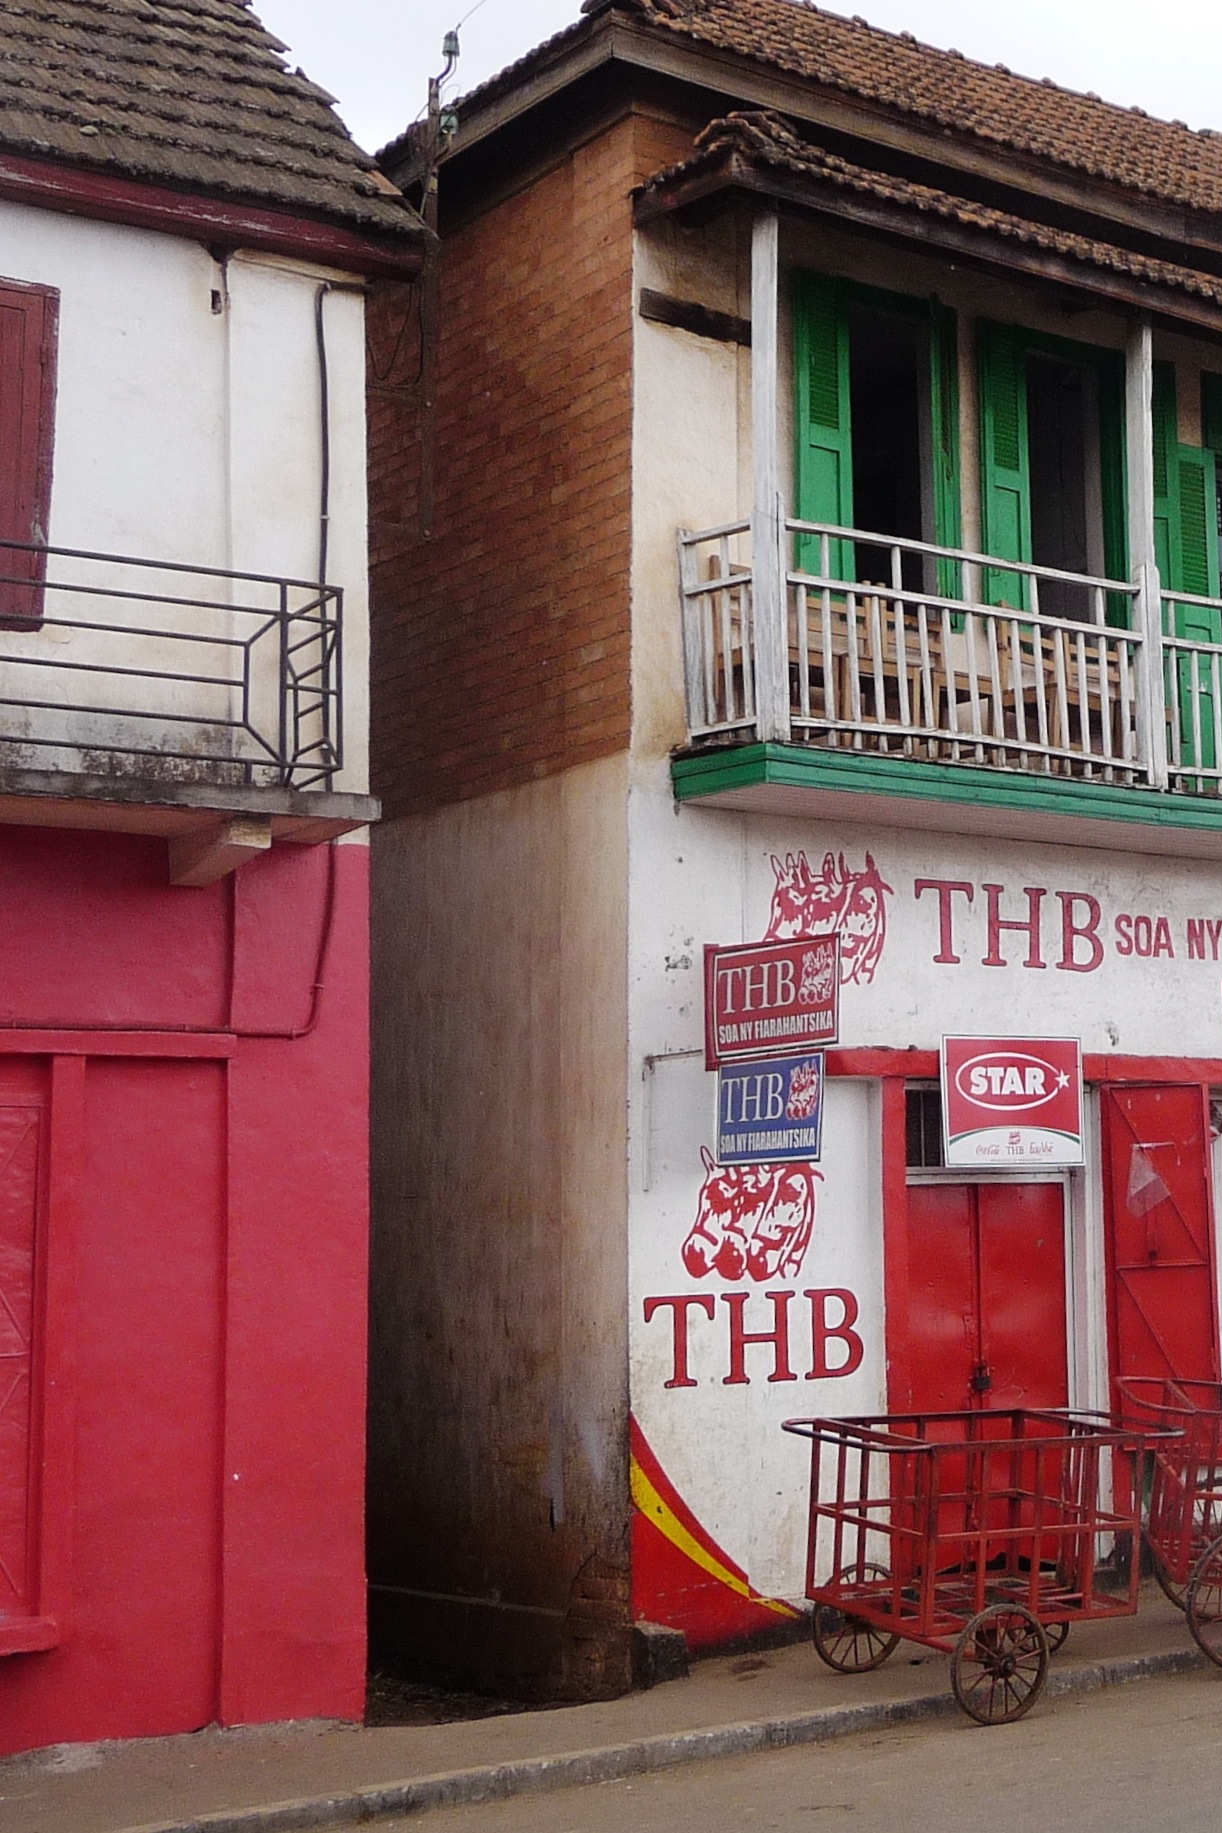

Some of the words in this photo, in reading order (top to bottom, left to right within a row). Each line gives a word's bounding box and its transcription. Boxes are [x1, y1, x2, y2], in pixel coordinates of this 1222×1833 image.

[914, 878, 1105, 973] THB
[1114, 914, 1175, 958] SOA
[1187, 918, 1222, 961] NY
[717, 959, 796, 1014] THB
[718, 1025, 739, 1044] SOA
[740, 1021, 753, 1041] NY
[755, 1009, 834, 1039] FIARAHANTSIKA
[721, 1073, 783, 1123] THB
[970, 1066, 1046, 1095] STAR
[720, 1134, 736, 1153] SOA
[737, 1133, 747, 1152] NY
[748, 1127, 815, 1152] FIARAHANTSIKA
[643, 1288, 864, 1389] THB
